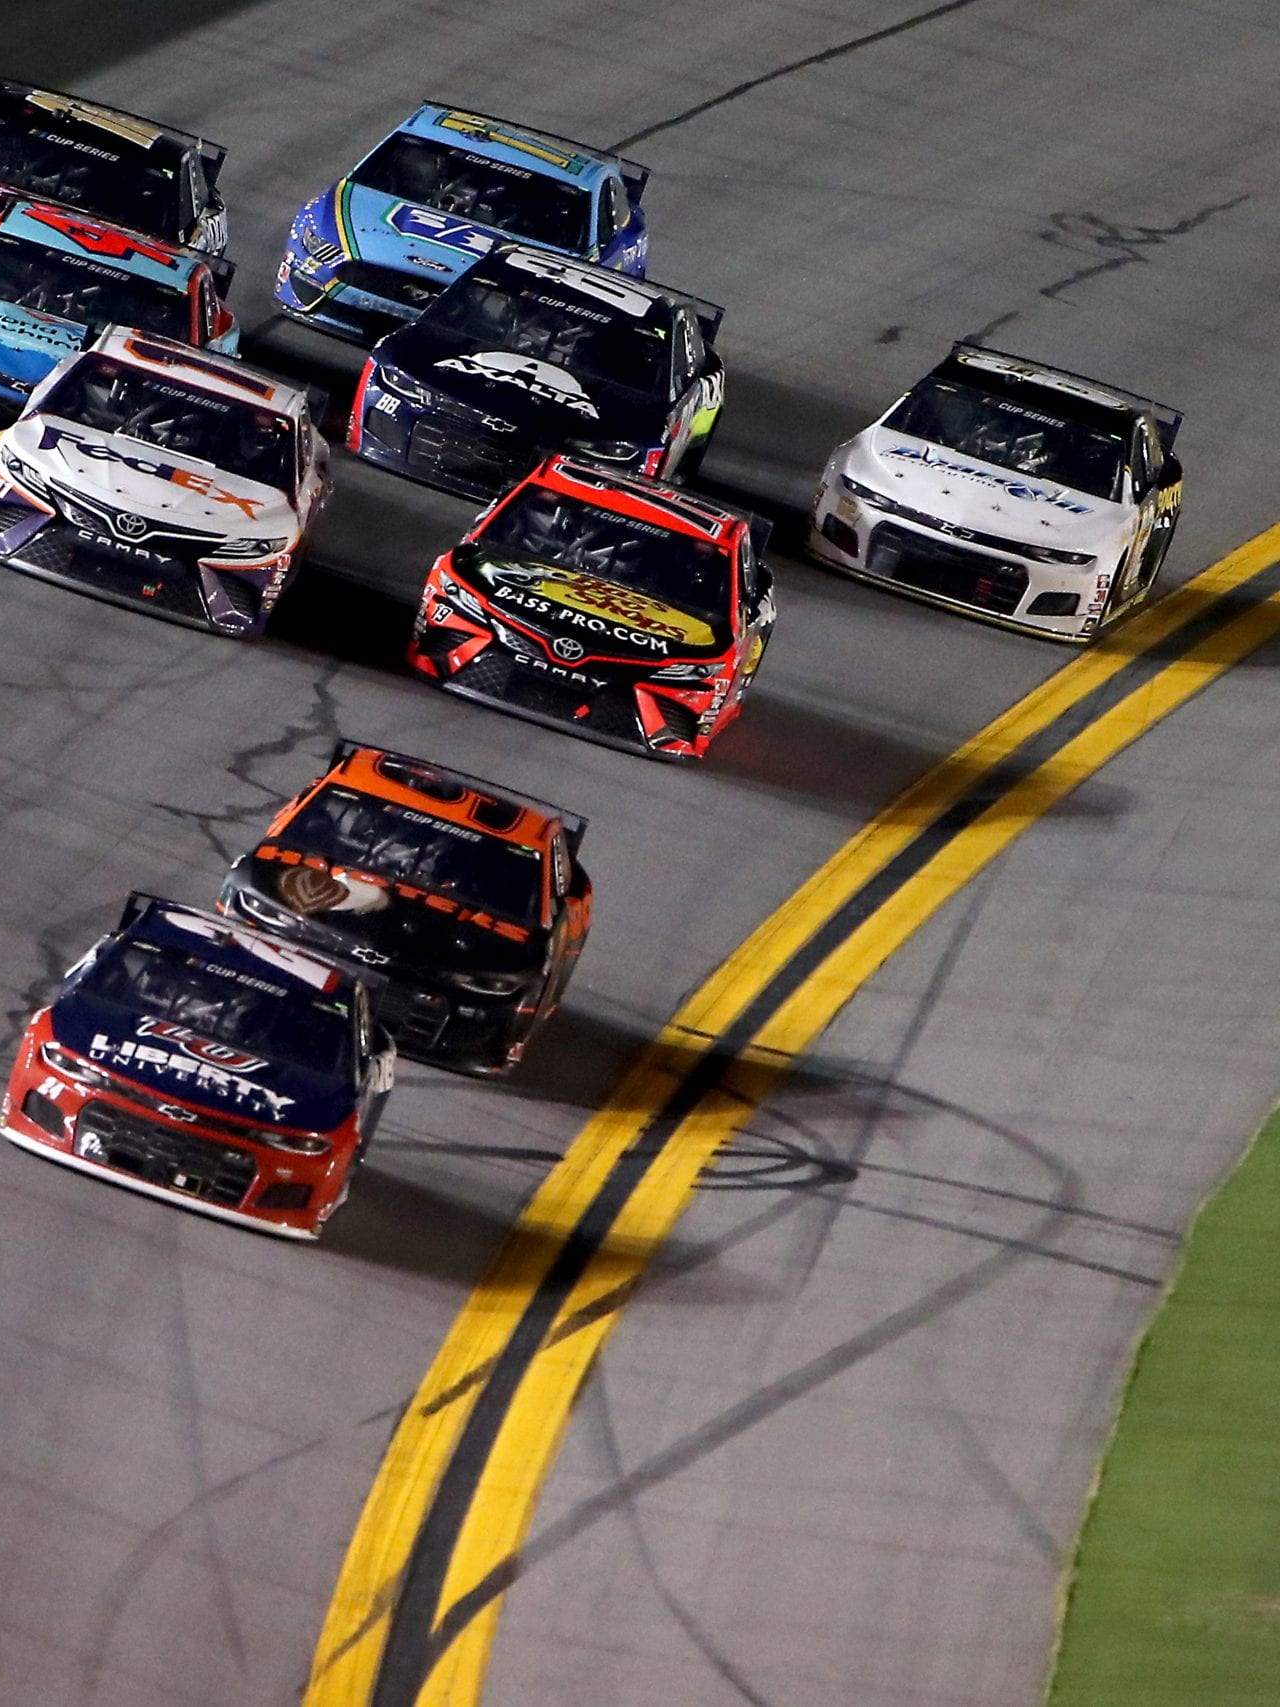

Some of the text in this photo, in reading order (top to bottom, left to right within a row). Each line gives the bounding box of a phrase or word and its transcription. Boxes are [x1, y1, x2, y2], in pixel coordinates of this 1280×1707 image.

[46, 134, 120, 162] CUP SERIES
[465, 155, 532, 179] CUP SERIES
[62, 256, 131, 281] CUP SERIES
[538, 296, 612, 324] CUP SERIES
[160, 386, 230, 412] CUP SERIES
[433, 358, 600, 420] AXALTA
[375, 393, 401, 415] 88
[998, 402, 1066, 428] CUP SERIES
[38, 425, 264, 521] FedEx
[600, 512, 671, 538] CUP SERIES
[78, 529, 172, 563] CAMRY
[430, 602, 453, 625] 19
[514, 653, 608, 688] CAMRY
[403, 811, 482, 842] CUP SERIES
[206, 963, 288, 998] CUP SERIES
[89, 1050, 286, 1121] UNIVERSITY
[91, 1033, 296, 1110] LIBERTY
